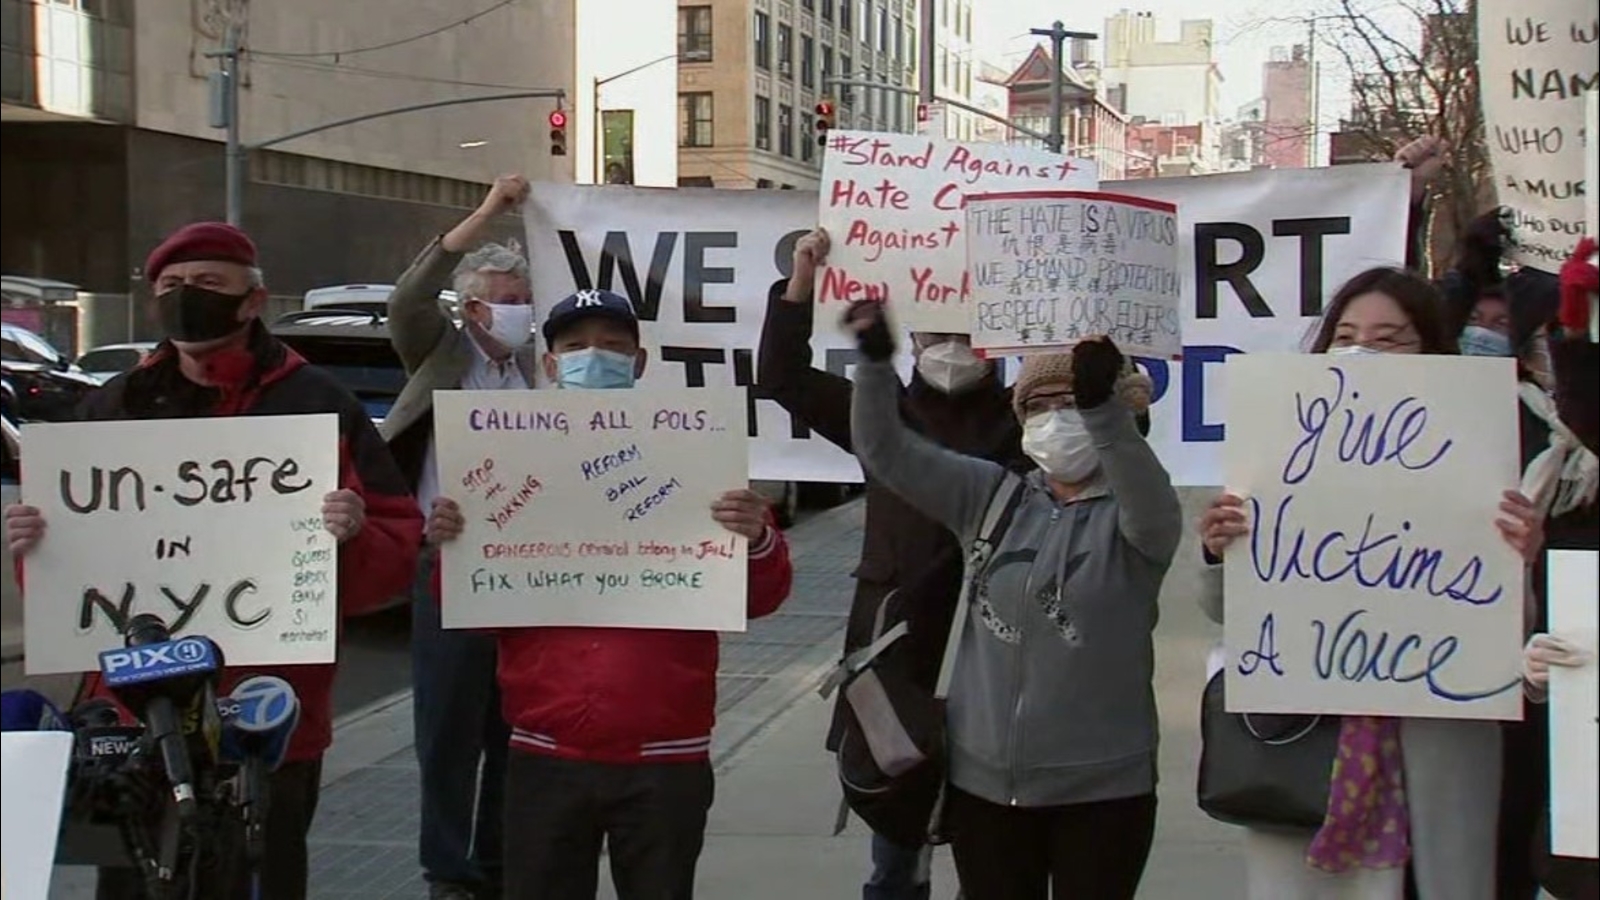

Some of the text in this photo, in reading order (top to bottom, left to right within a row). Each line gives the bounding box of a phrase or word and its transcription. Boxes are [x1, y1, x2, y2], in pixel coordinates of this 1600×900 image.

[1506, 18, 1551, 45] WE
[1496, 125, 1563, 154] WHO
[829, 136, 1078, 183] #Stand Against
[830, 179, 910, 210] Hate
[846, 220, 960, 262] Against
[972, 204, 1176, 246] THE HATE IS A VIRUS
[557, 230, 738, 323] WE
[819, 267, 889, 304] New
[975, 262, 1004, 286] WE
[1014, 257, 1087, 280] DEMAND
[977, 298, 1059, 331] RESPECT
[1070, 297, 1112, 330] OUR
[469, 409, 570, 434] CALLING
[589, 411, 632, 430] ALL
[581, 444, 642, 480] REFORM
[605, 474, 648, 502] BAIL
[626, 477, 682, 521] REFORM
[156, 535, 191, 560] IN
[482, 543, 570, 559] DANGEROUS
[1250, 495, 1503, 605] Victims
[471, 568, 513, 593] FIX
[527, 571, 584, 588] WHAT
[641, 570, 703, 588] BROKE
[78, 580, 273, 636] NYC
[103, 646, 176, 673] PIX
[1238, 609, 1522, 701] A Voice
